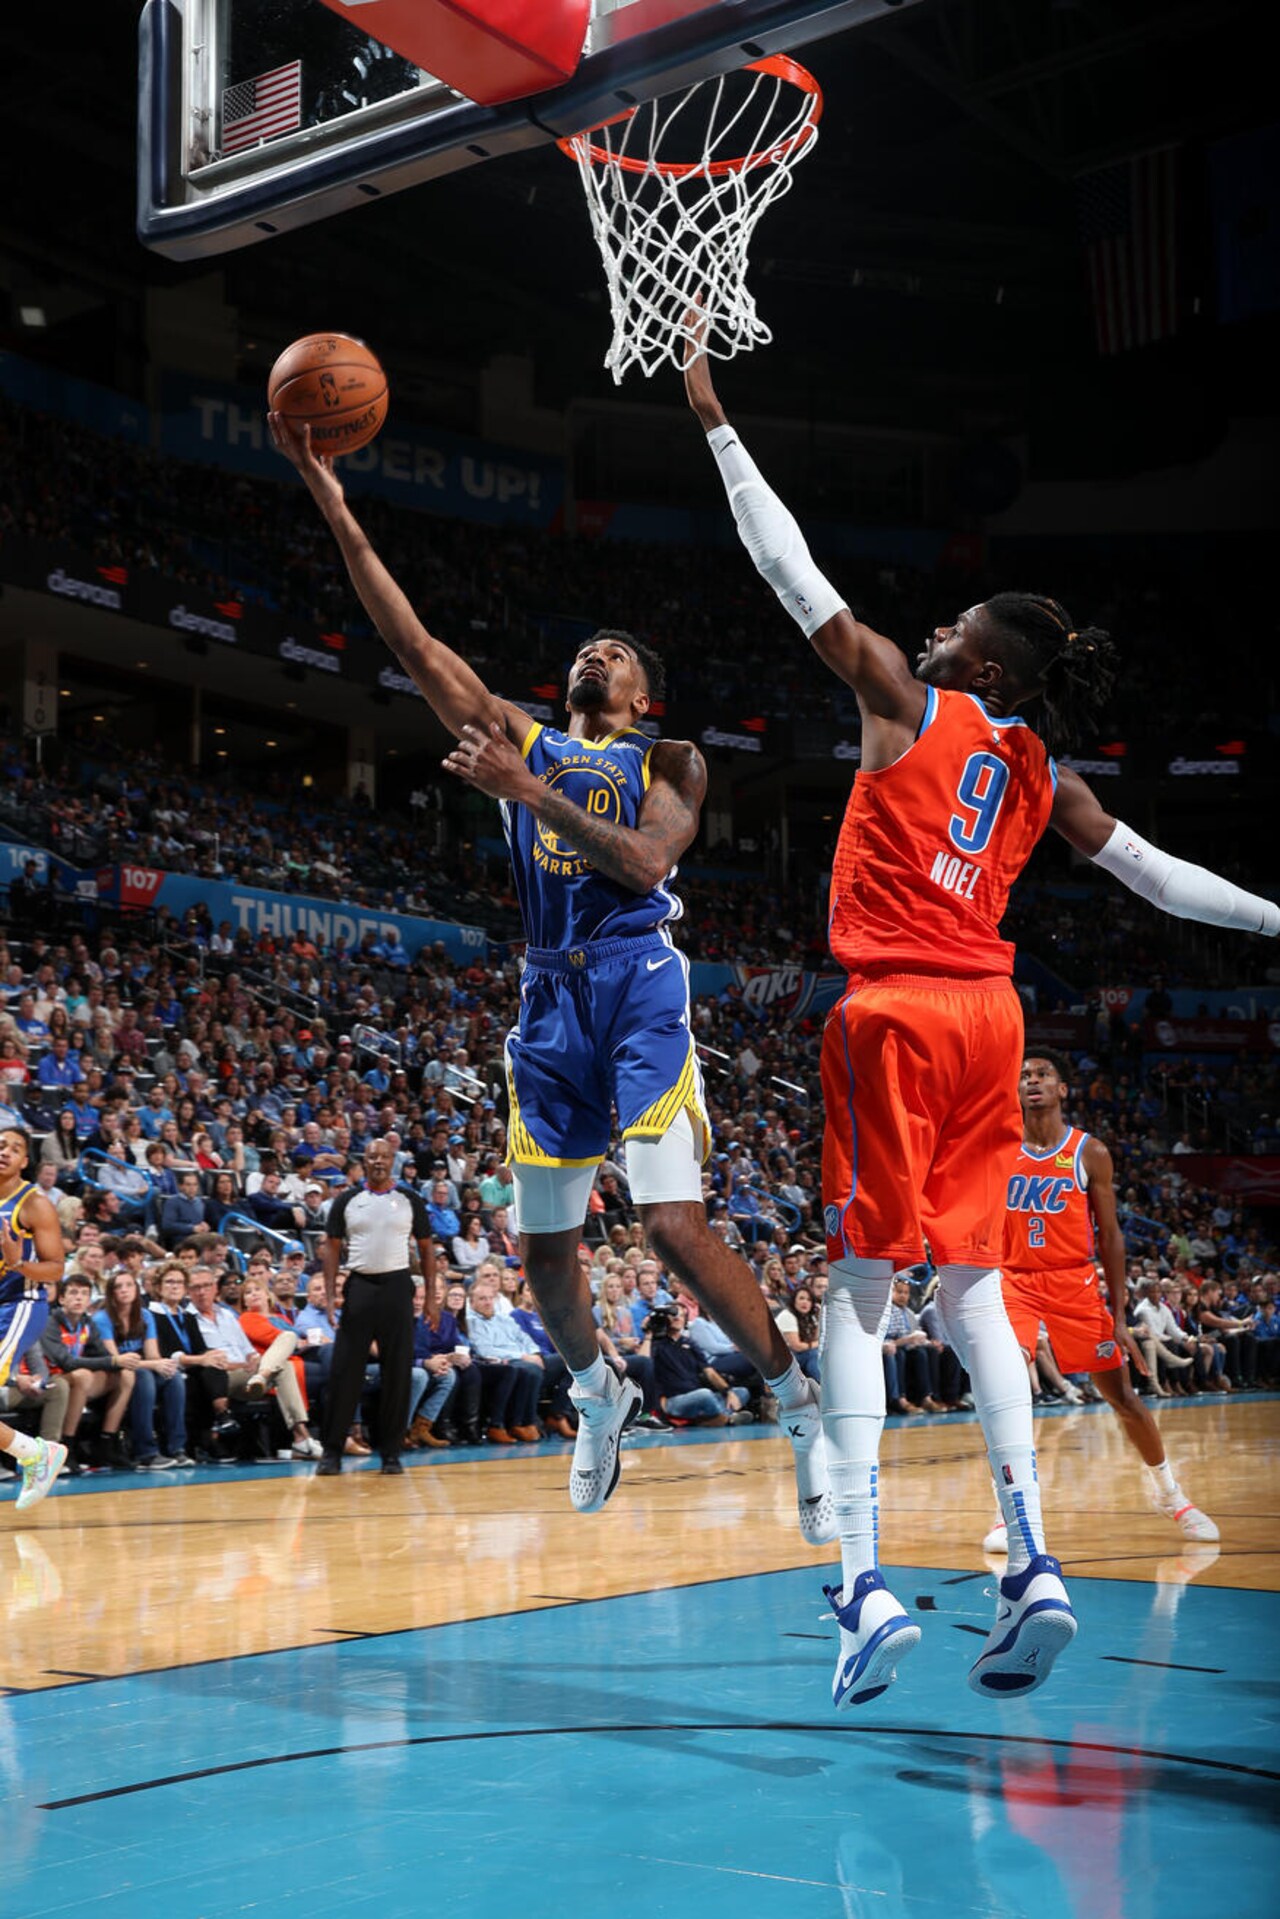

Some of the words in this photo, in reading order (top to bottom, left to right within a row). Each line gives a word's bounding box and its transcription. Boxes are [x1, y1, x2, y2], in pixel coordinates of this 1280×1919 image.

[190, 395, 446, 489] THDER
[459, 455, 542, 511] UP!
[538, 755, 590, 783] GOLDEN
[595, 758, 628, 786] STATE
[586, 788, 610, 814] 10
[948, 751, 1010, 855] 9
[124, 868, 158, 890] 107
[930, 851, 983, 900] NOEL
[460, 928, 486, 947] 107
[1006, 1175, 1074, 1214] OKC
[1029, 1218, 1046, 1248] 2
